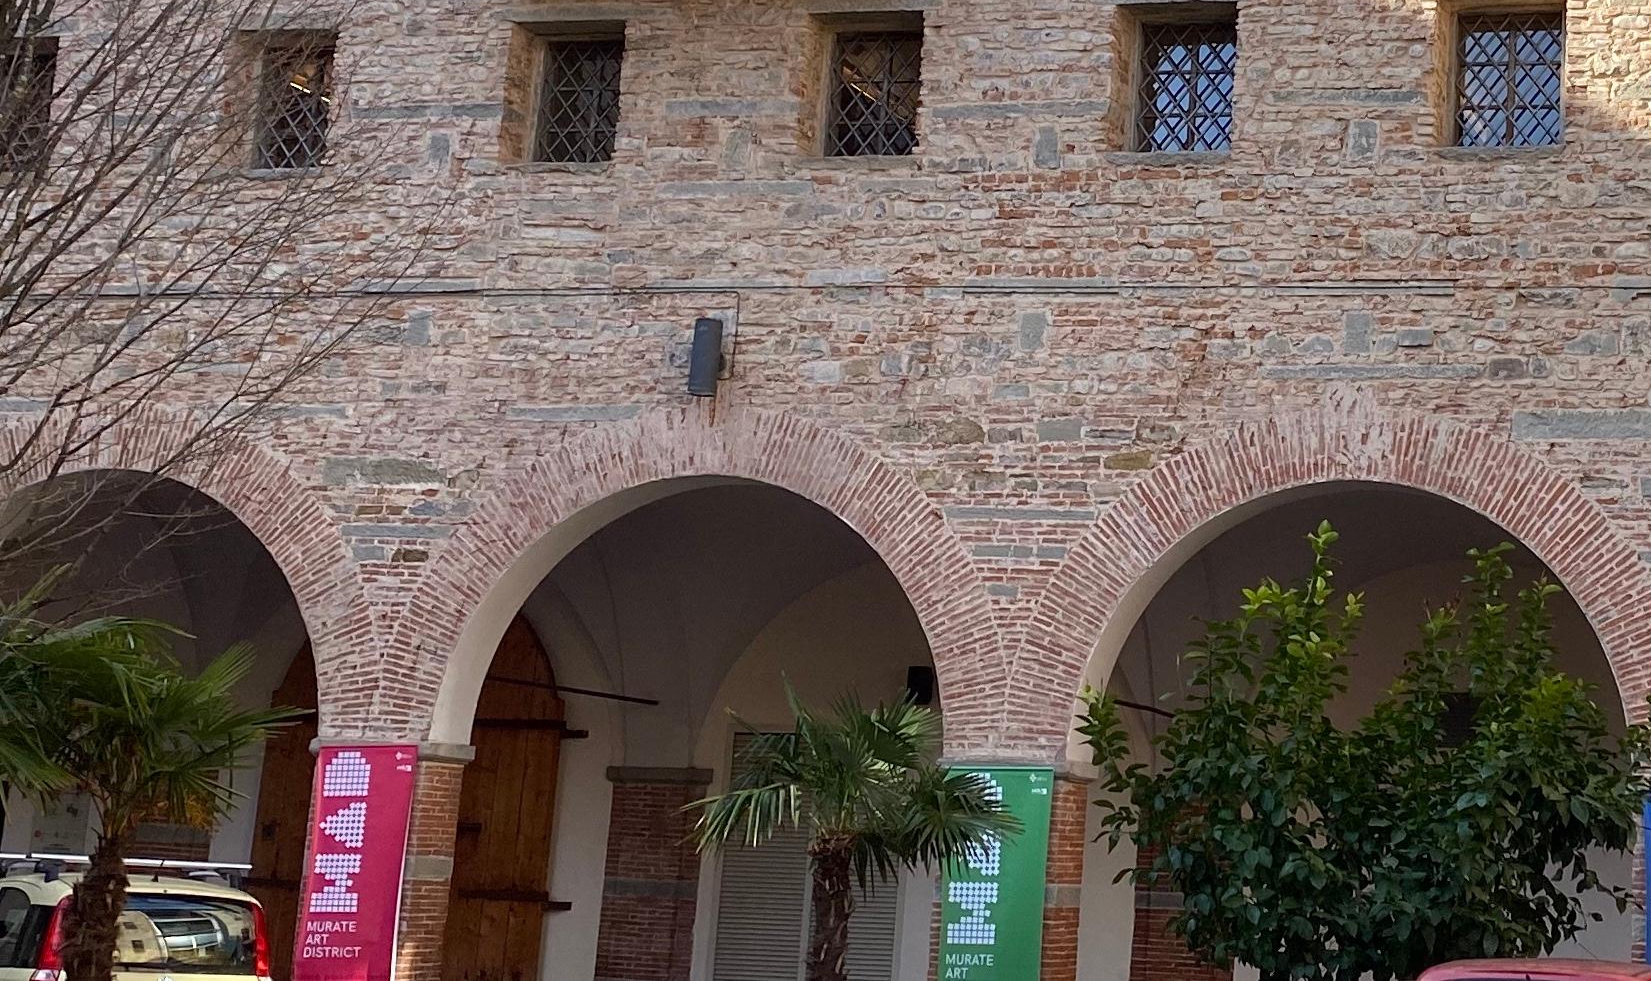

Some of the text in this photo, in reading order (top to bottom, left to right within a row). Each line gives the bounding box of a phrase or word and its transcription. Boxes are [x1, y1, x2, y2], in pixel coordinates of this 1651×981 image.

[306, 921, 357, 933] MURATE
[305, 934, 329, 946] ART
[303, 946, 362, 959] DISTRICT
[945, 953, 995, 967] MURATE
[945, 967, 968, 979] ART
